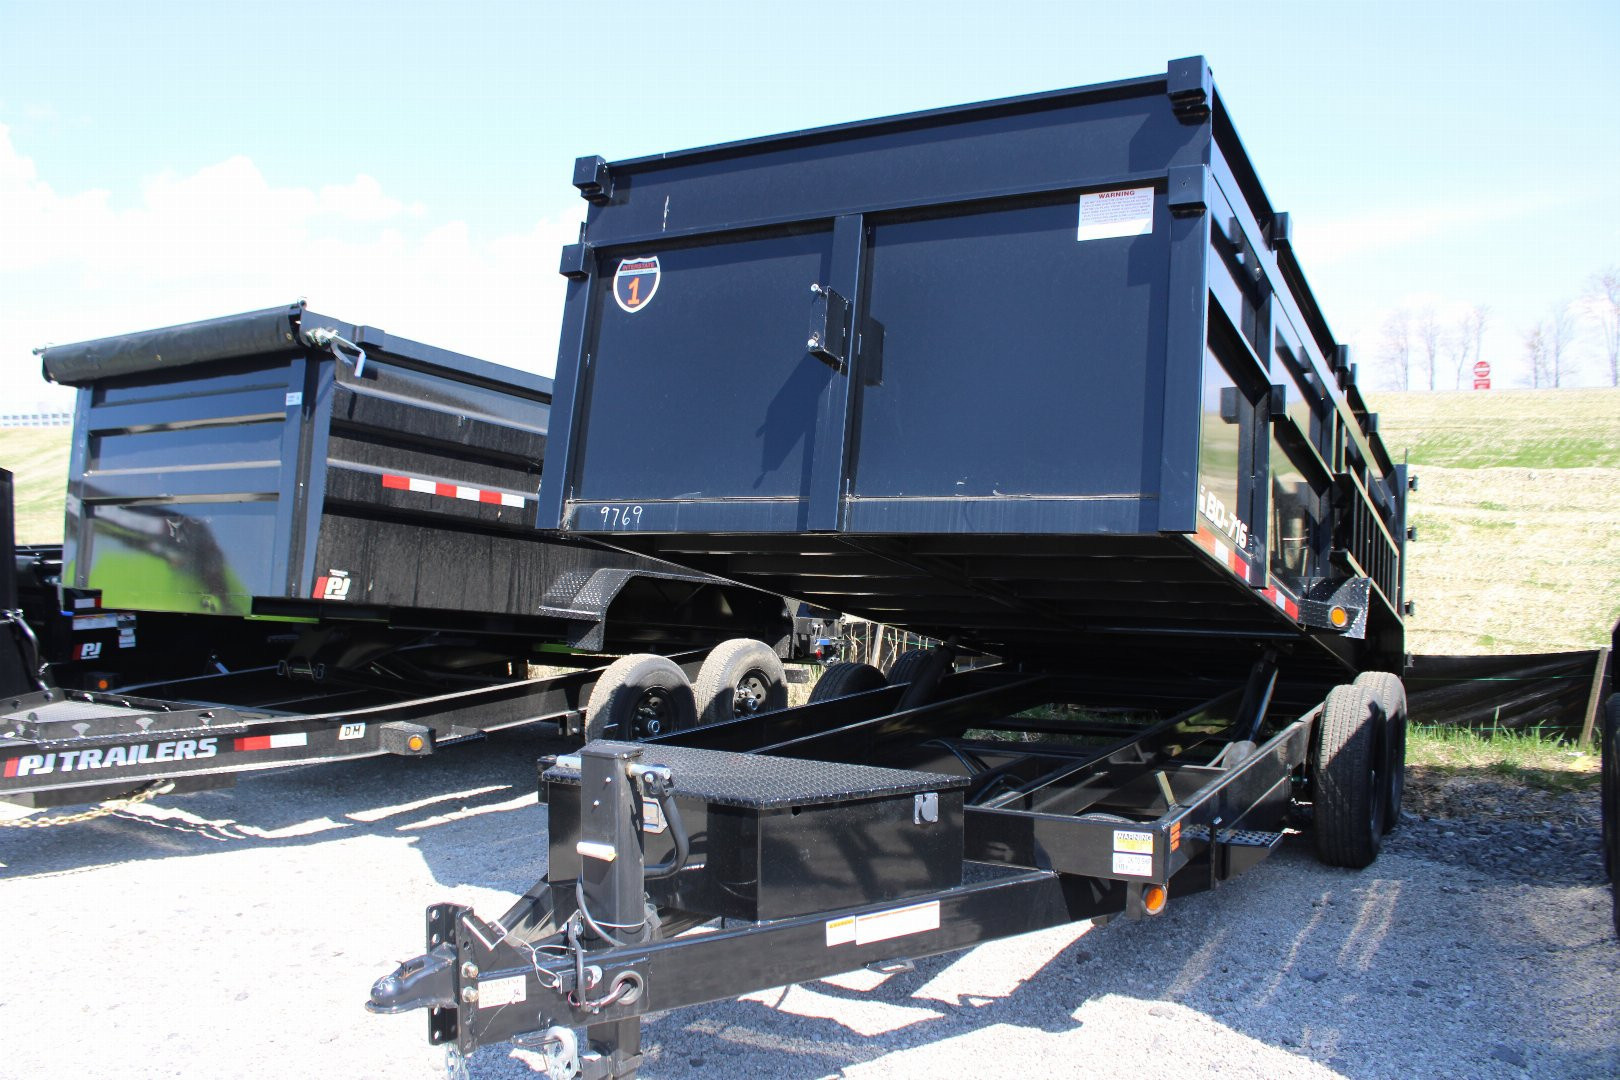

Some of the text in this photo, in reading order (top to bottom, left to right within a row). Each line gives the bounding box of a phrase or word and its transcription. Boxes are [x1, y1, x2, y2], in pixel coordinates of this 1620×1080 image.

[1098, 190, 1135, 199] WARNING
[627, 277, 640, 305] 1
[600, 505, 643, 526] 9769
[325, 576, 351, 596] PJ
[80, 642, 102, 656] PJ
[16, 738, 218, 776] PJ TRAILERS
[1116, 832, 1152, 841] WARNING
